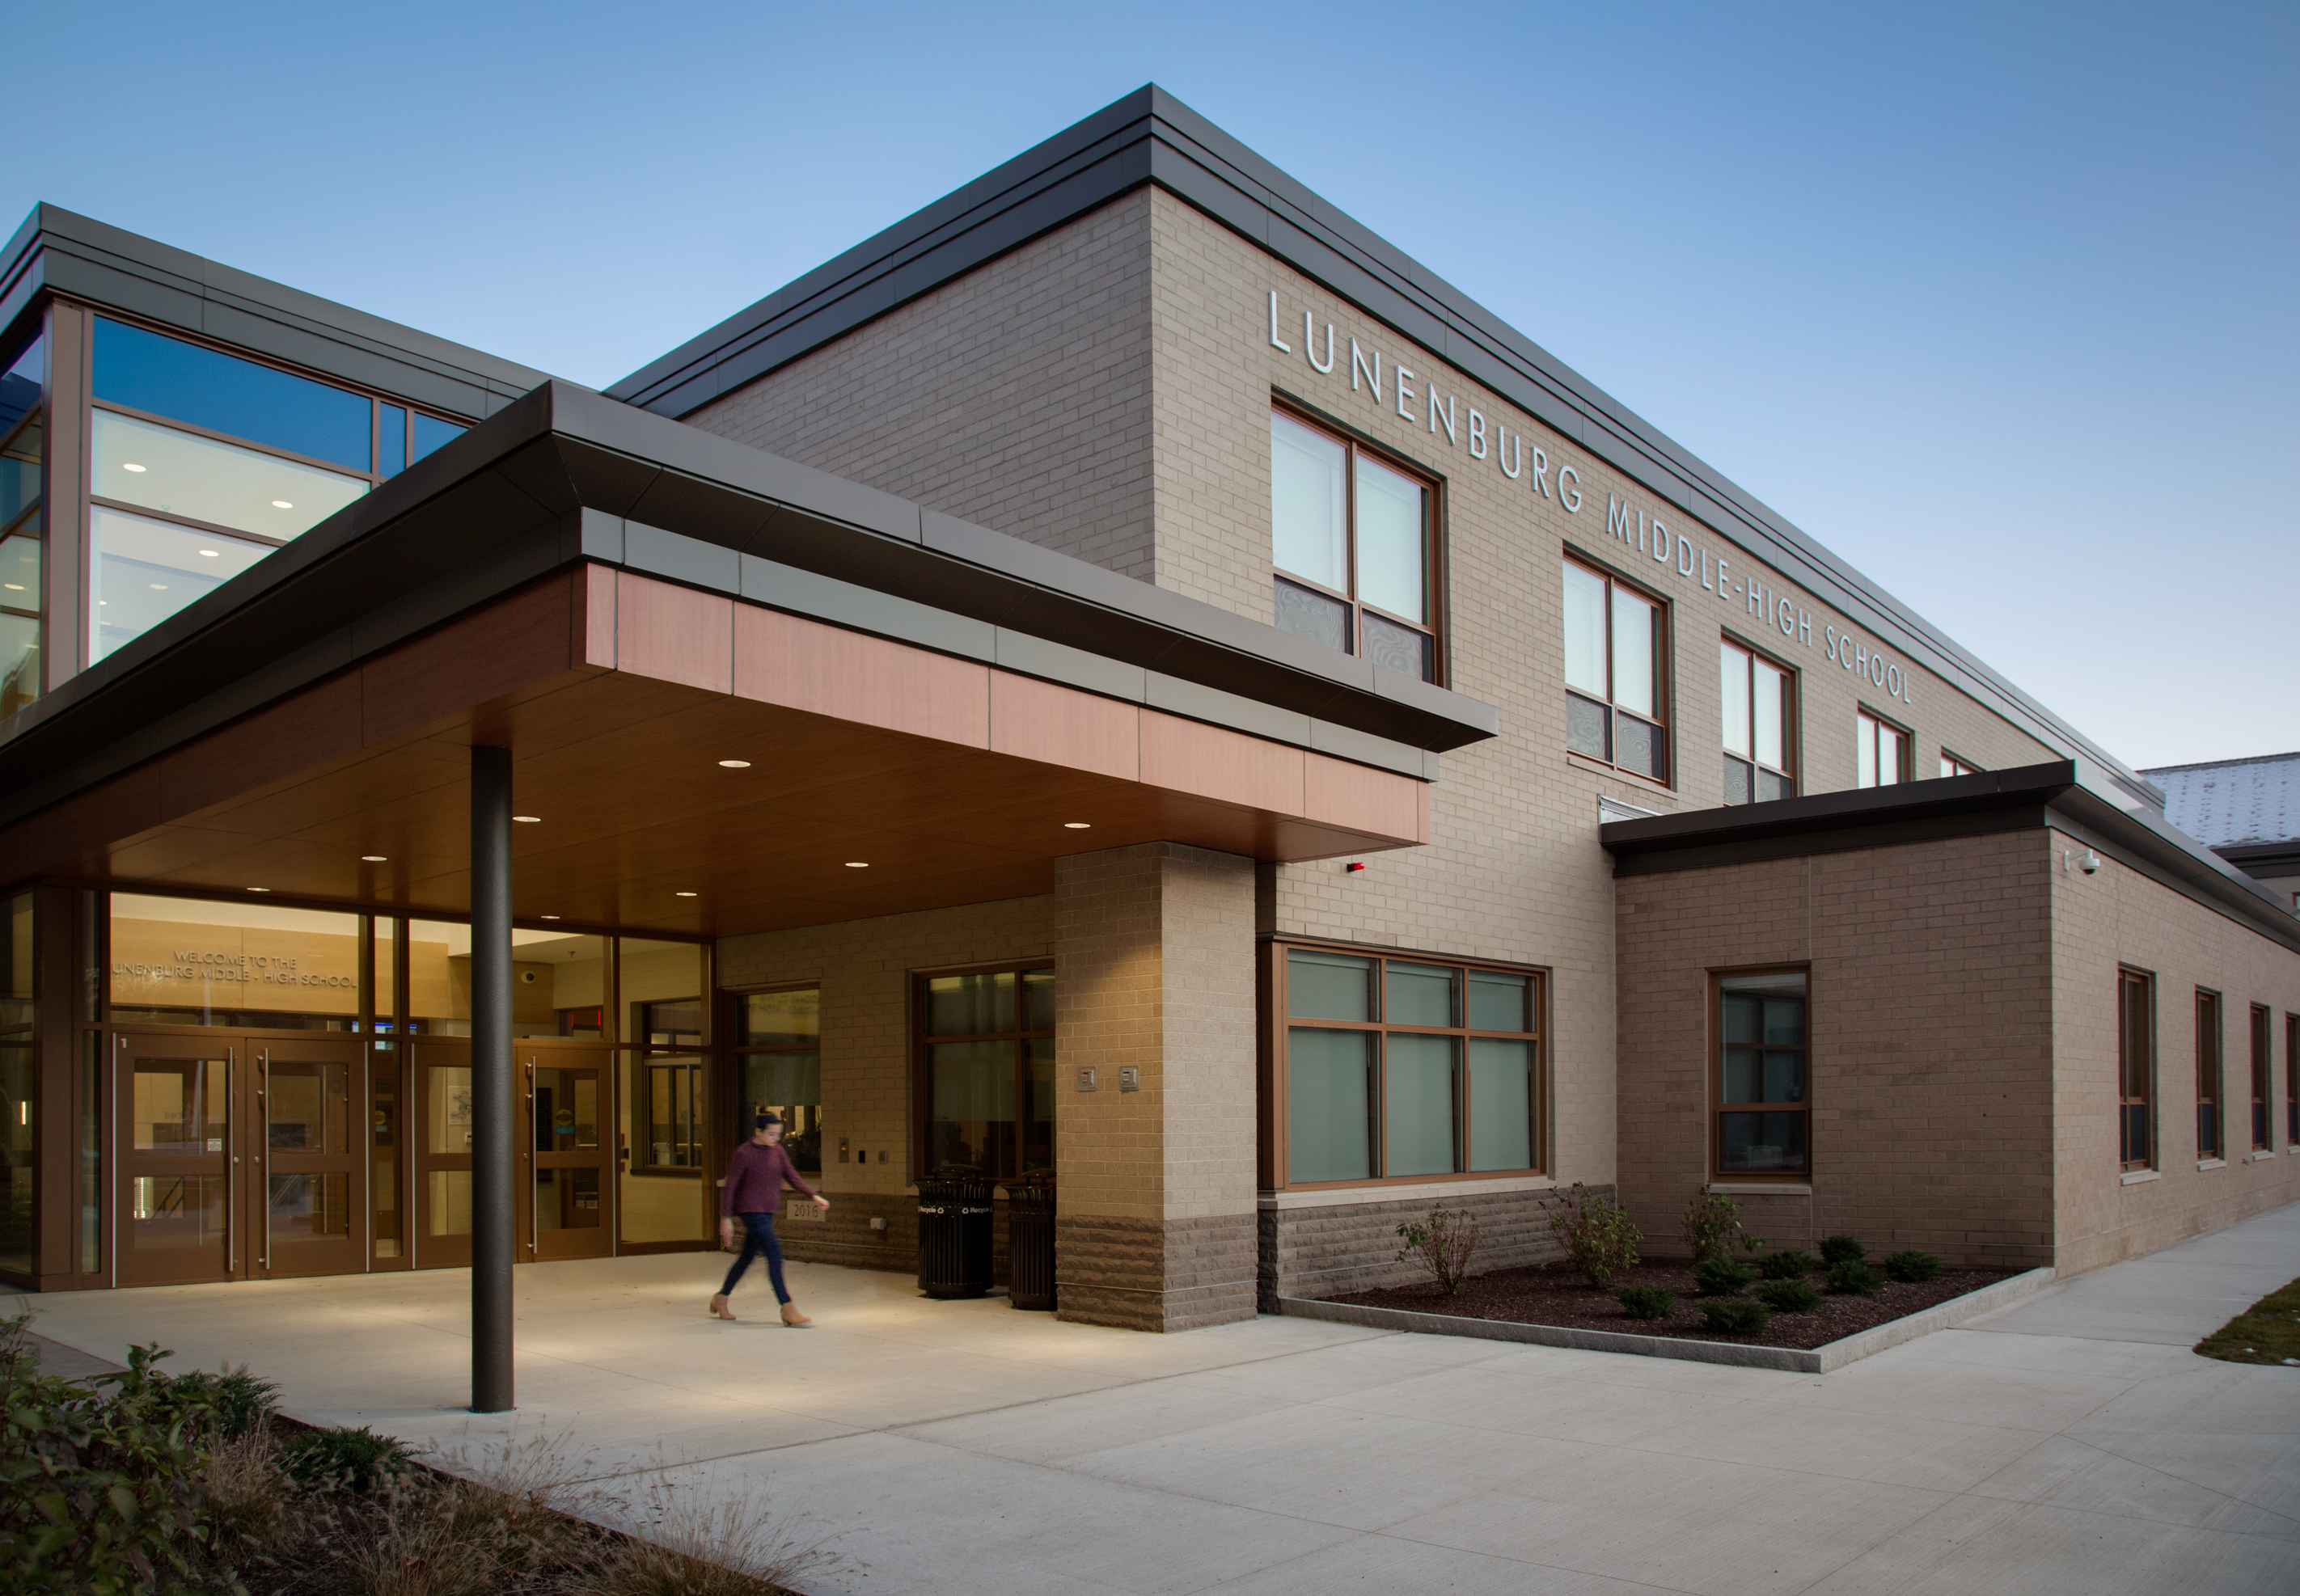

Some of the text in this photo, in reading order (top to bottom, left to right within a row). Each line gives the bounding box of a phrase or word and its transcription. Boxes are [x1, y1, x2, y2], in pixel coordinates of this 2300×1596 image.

[1268, 289, 1911, 704] LUNENBURG MIDDLE-HIGH SCHOOL
[174, 950, 297, 970] WELCOME TO THE
[112, 962, 195, 978] UNENBURG
[198, 969, 249, 982] MIDDLE
[263, 971, 298, 984] HIGH
[302, 973, 357, 988] SCHOOL
[120, 1038, 127, 1048] 1
[794, 1204, 818, 1218] 2016
